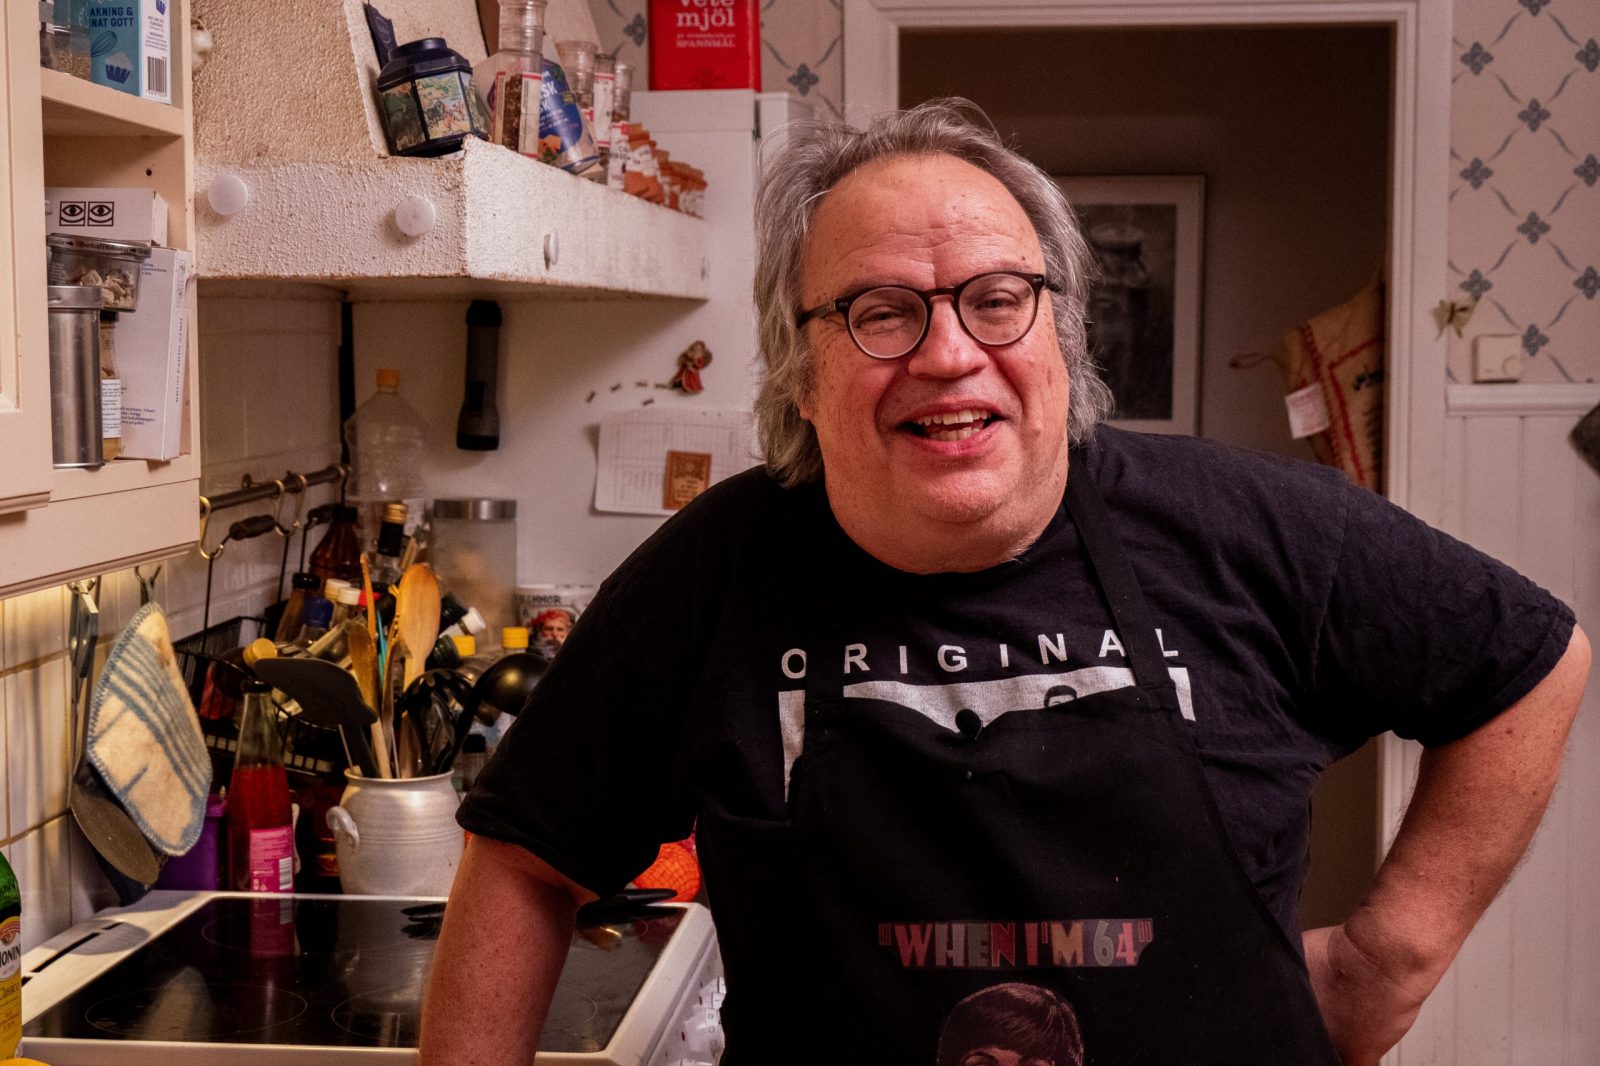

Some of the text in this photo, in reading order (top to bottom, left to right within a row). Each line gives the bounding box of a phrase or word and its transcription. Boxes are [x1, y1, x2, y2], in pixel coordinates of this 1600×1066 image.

[110, 17, 134, 27] GOTT
[676, 8, 735, 32] mjöl
[781, 628, 1179, 679] ORIGINAL
[1025, 922, 1084, 966] I'M
